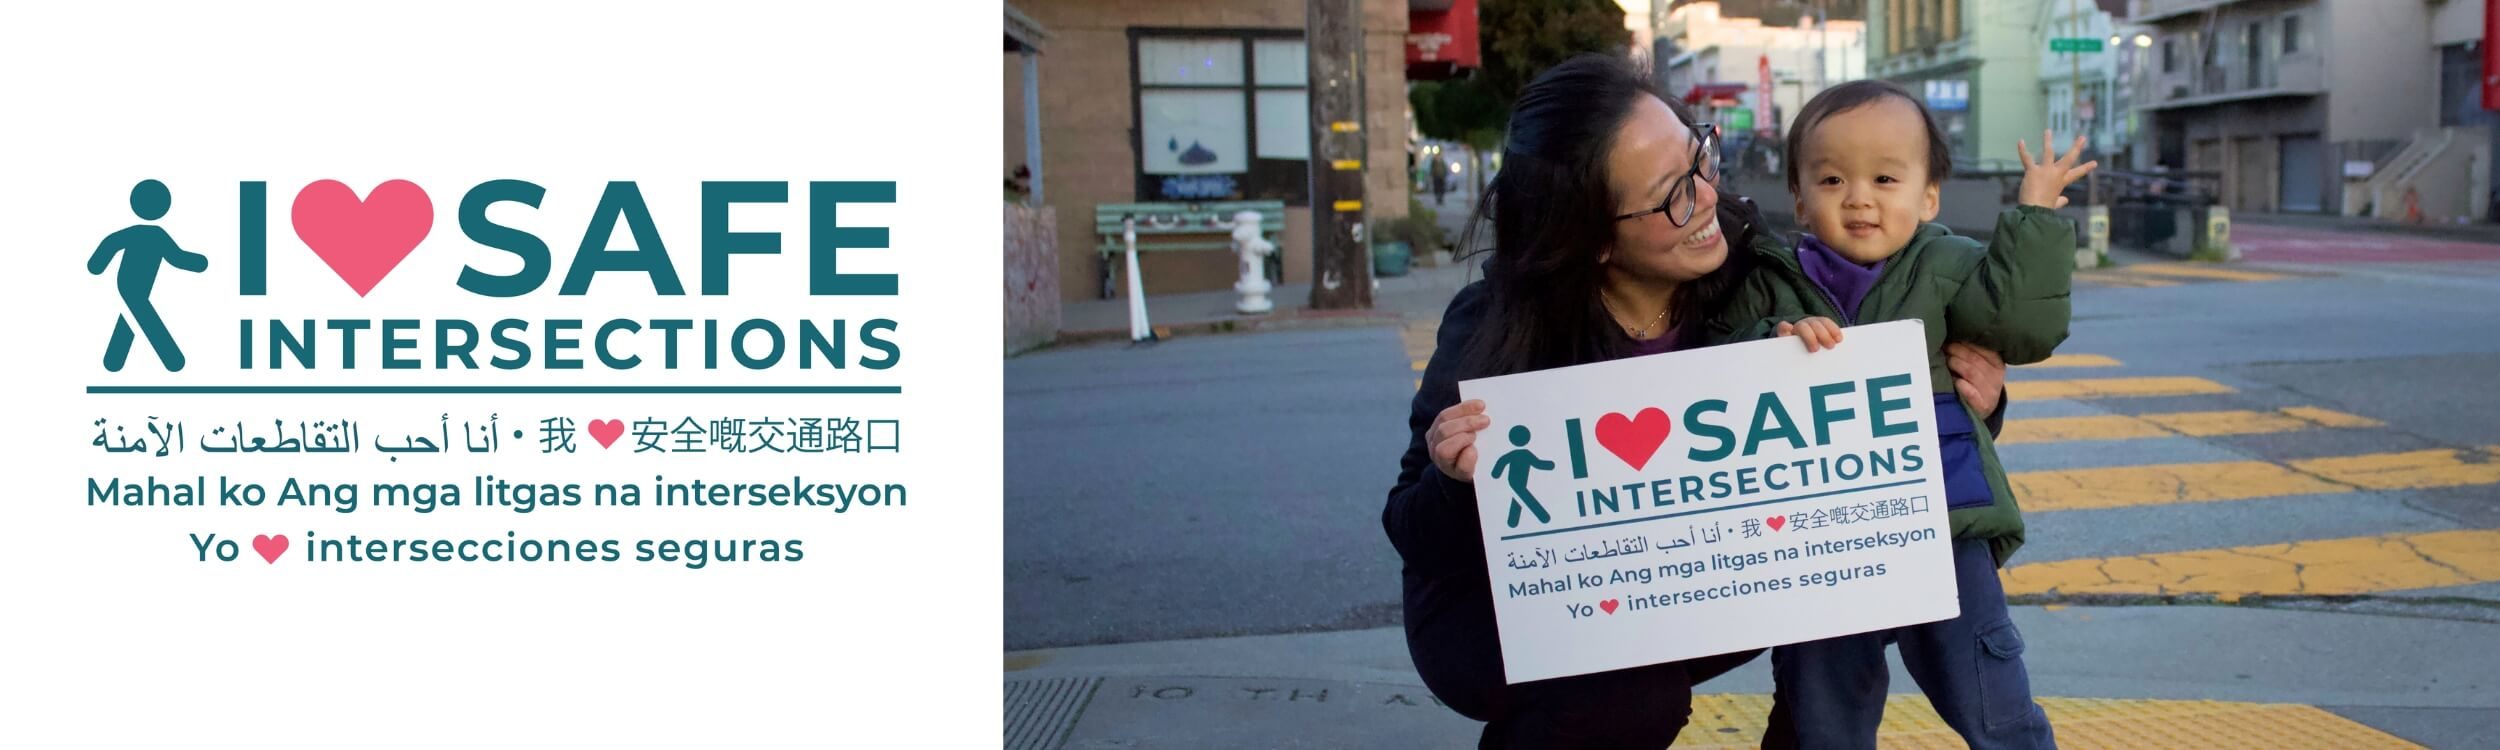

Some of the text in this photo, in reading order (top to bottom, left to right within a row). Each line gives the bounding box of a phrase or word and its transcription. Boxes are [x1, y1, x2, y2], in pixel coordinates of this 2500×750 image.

[1565, 373, 1919, 479] I SAFE
[1577, 444, 1924, 517] INTERSECTIONS
[1508, 527, 1936, 599] Mahal ko Ang mga litgas na interseksyon
[1741, 518, 1762, 539] 我
[1566, 563, 1887, 619] Yo intersecciones seguras
